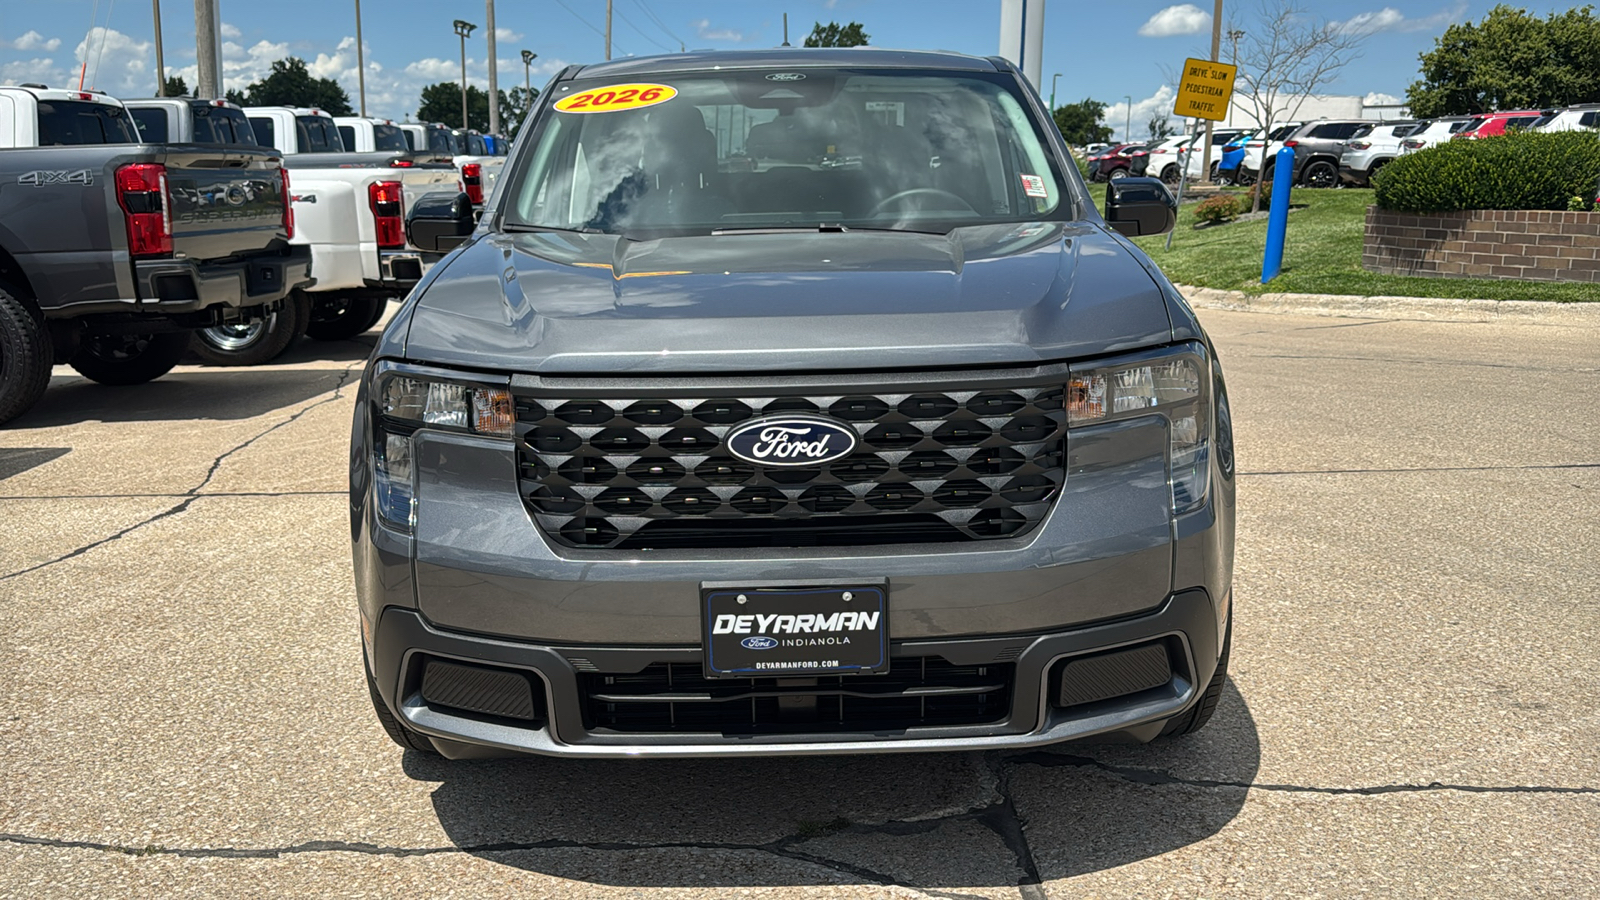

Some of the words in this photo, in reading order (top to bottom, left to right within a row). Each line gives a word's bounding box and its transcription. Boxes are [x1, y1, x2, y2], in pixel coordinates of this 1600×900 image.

[772, 73, 799, 81] Ford
[1189, 67, 1208, 78] DRIVE
[1211, 70, 1228, 81] SLOW
[1185, 83, 1224, 97] PEDESTRIAN
[566, 87, 664, 110] 2026
[1189, 100, 1215, 112] TRAFFIC
[181, 211, 244, 225] SUPER
[752, 426, 831, 458] Ford
[712, 611, 880, 635] DEYARMAN
[748, 638, 771, 647] Ford
[782, 636, 851, 647] INDIANOLA
[755, 660, 839, 670] DEYARMANFORD.COM
